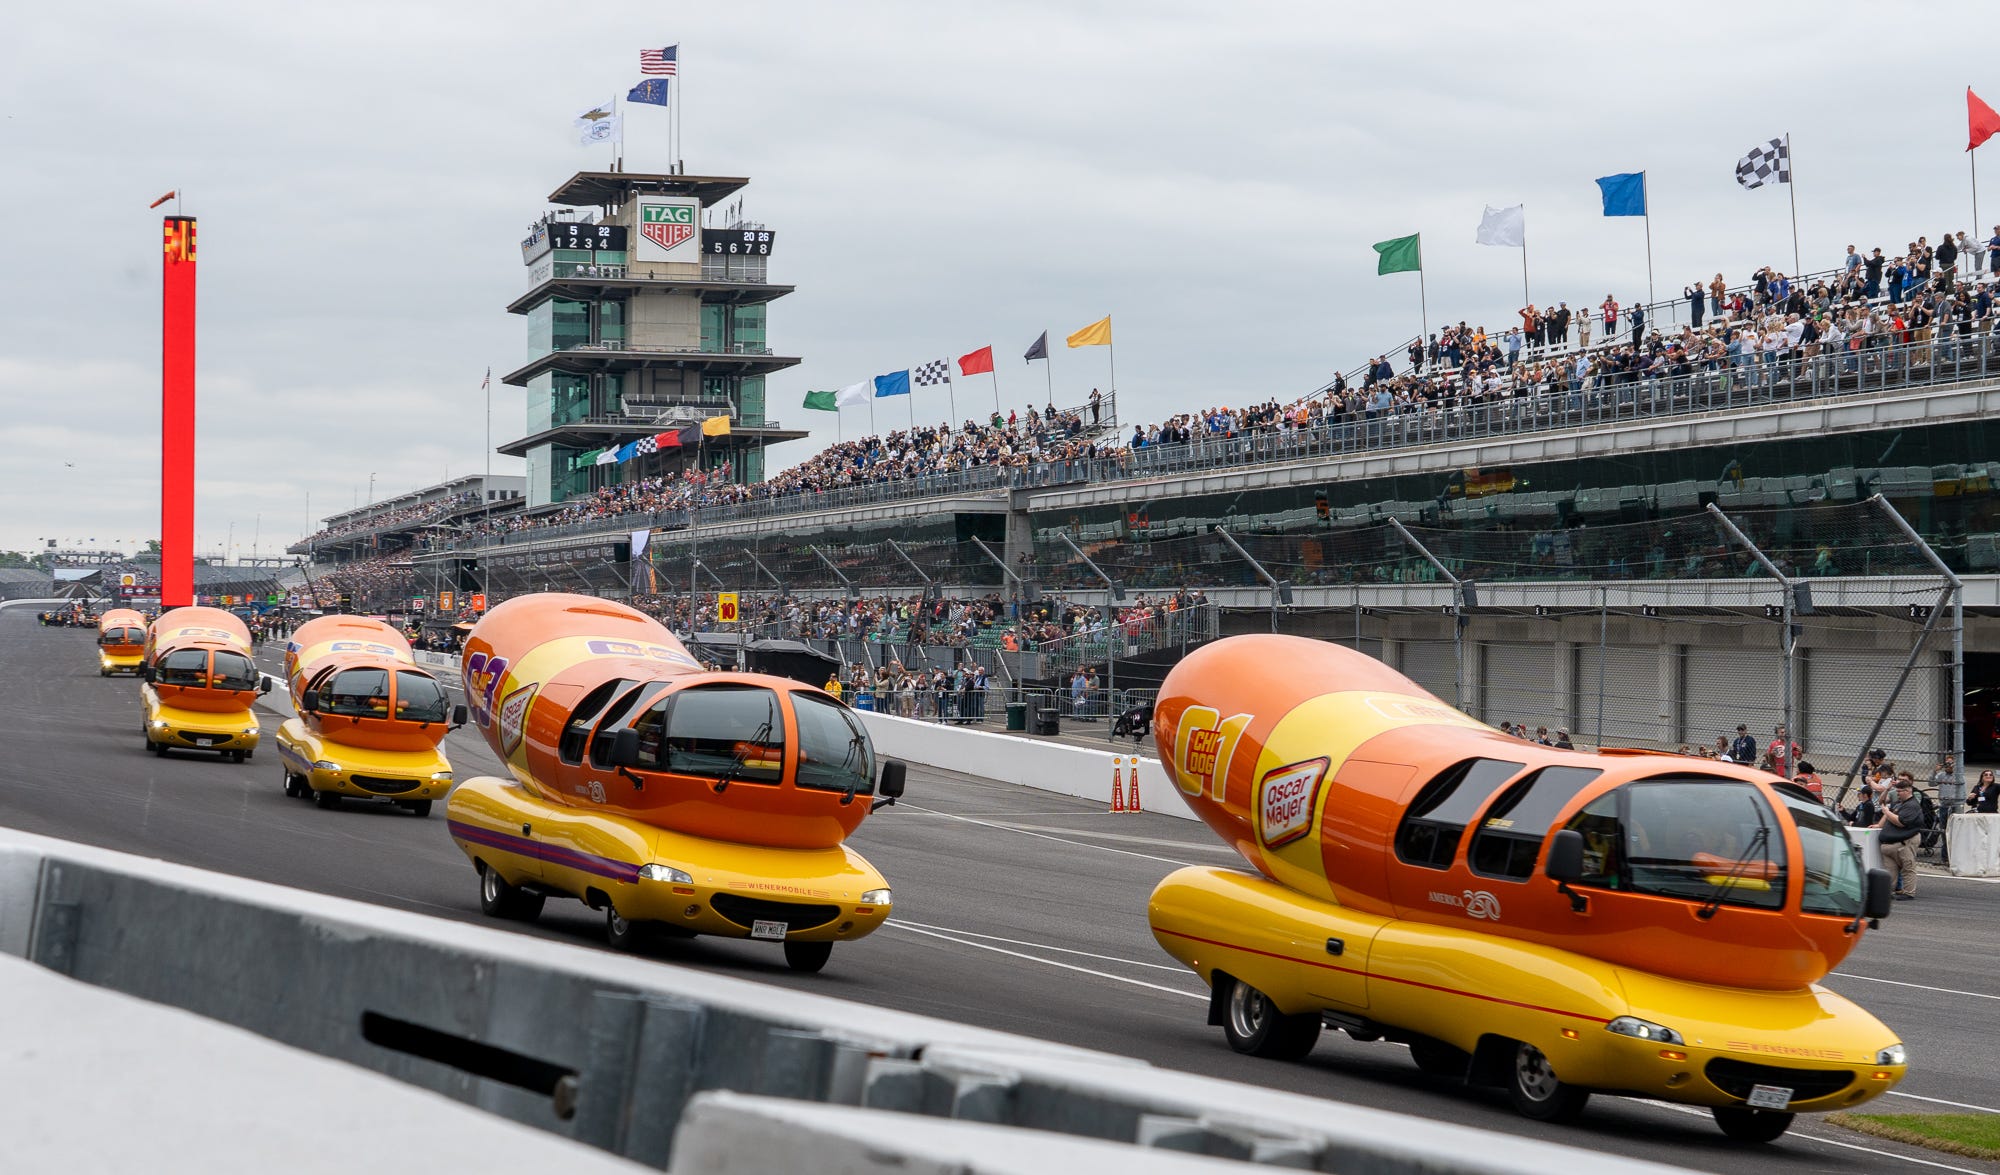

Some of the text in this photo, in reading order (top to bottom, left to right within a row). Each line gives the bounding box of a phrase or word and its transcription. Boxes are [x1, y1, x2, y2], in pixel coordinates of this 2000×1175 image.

[646, 207, 689, 222] TAG
[569, 225, 610, 237] 5 22
[645, 224, 691, 246] HEUER
[743, 231, 770, 242] 20 26
[555, 237, 561, 247] 1
[569, 237, 578, 248] 2
[584, 238, 592, 248] 3
[600, 238, 608, 249] 4
[714, 242, 722, 253] 5
[729, 243, 738, 253] 6
[744, 243, 753, 254] 7
[759, 243, 768, 254] 8
[443, 598, 449, 608] 9
[721, 602, 736, 620] 10
[1193, 730, 1219, 753] CHI
[1190, 751, 1215, 775] DOG
[1268, 775, 1311, 806] Oscar
[1266, 796, 1306, 829] Mayer
[748, 882, 813, 896] WIENERMOBILE
